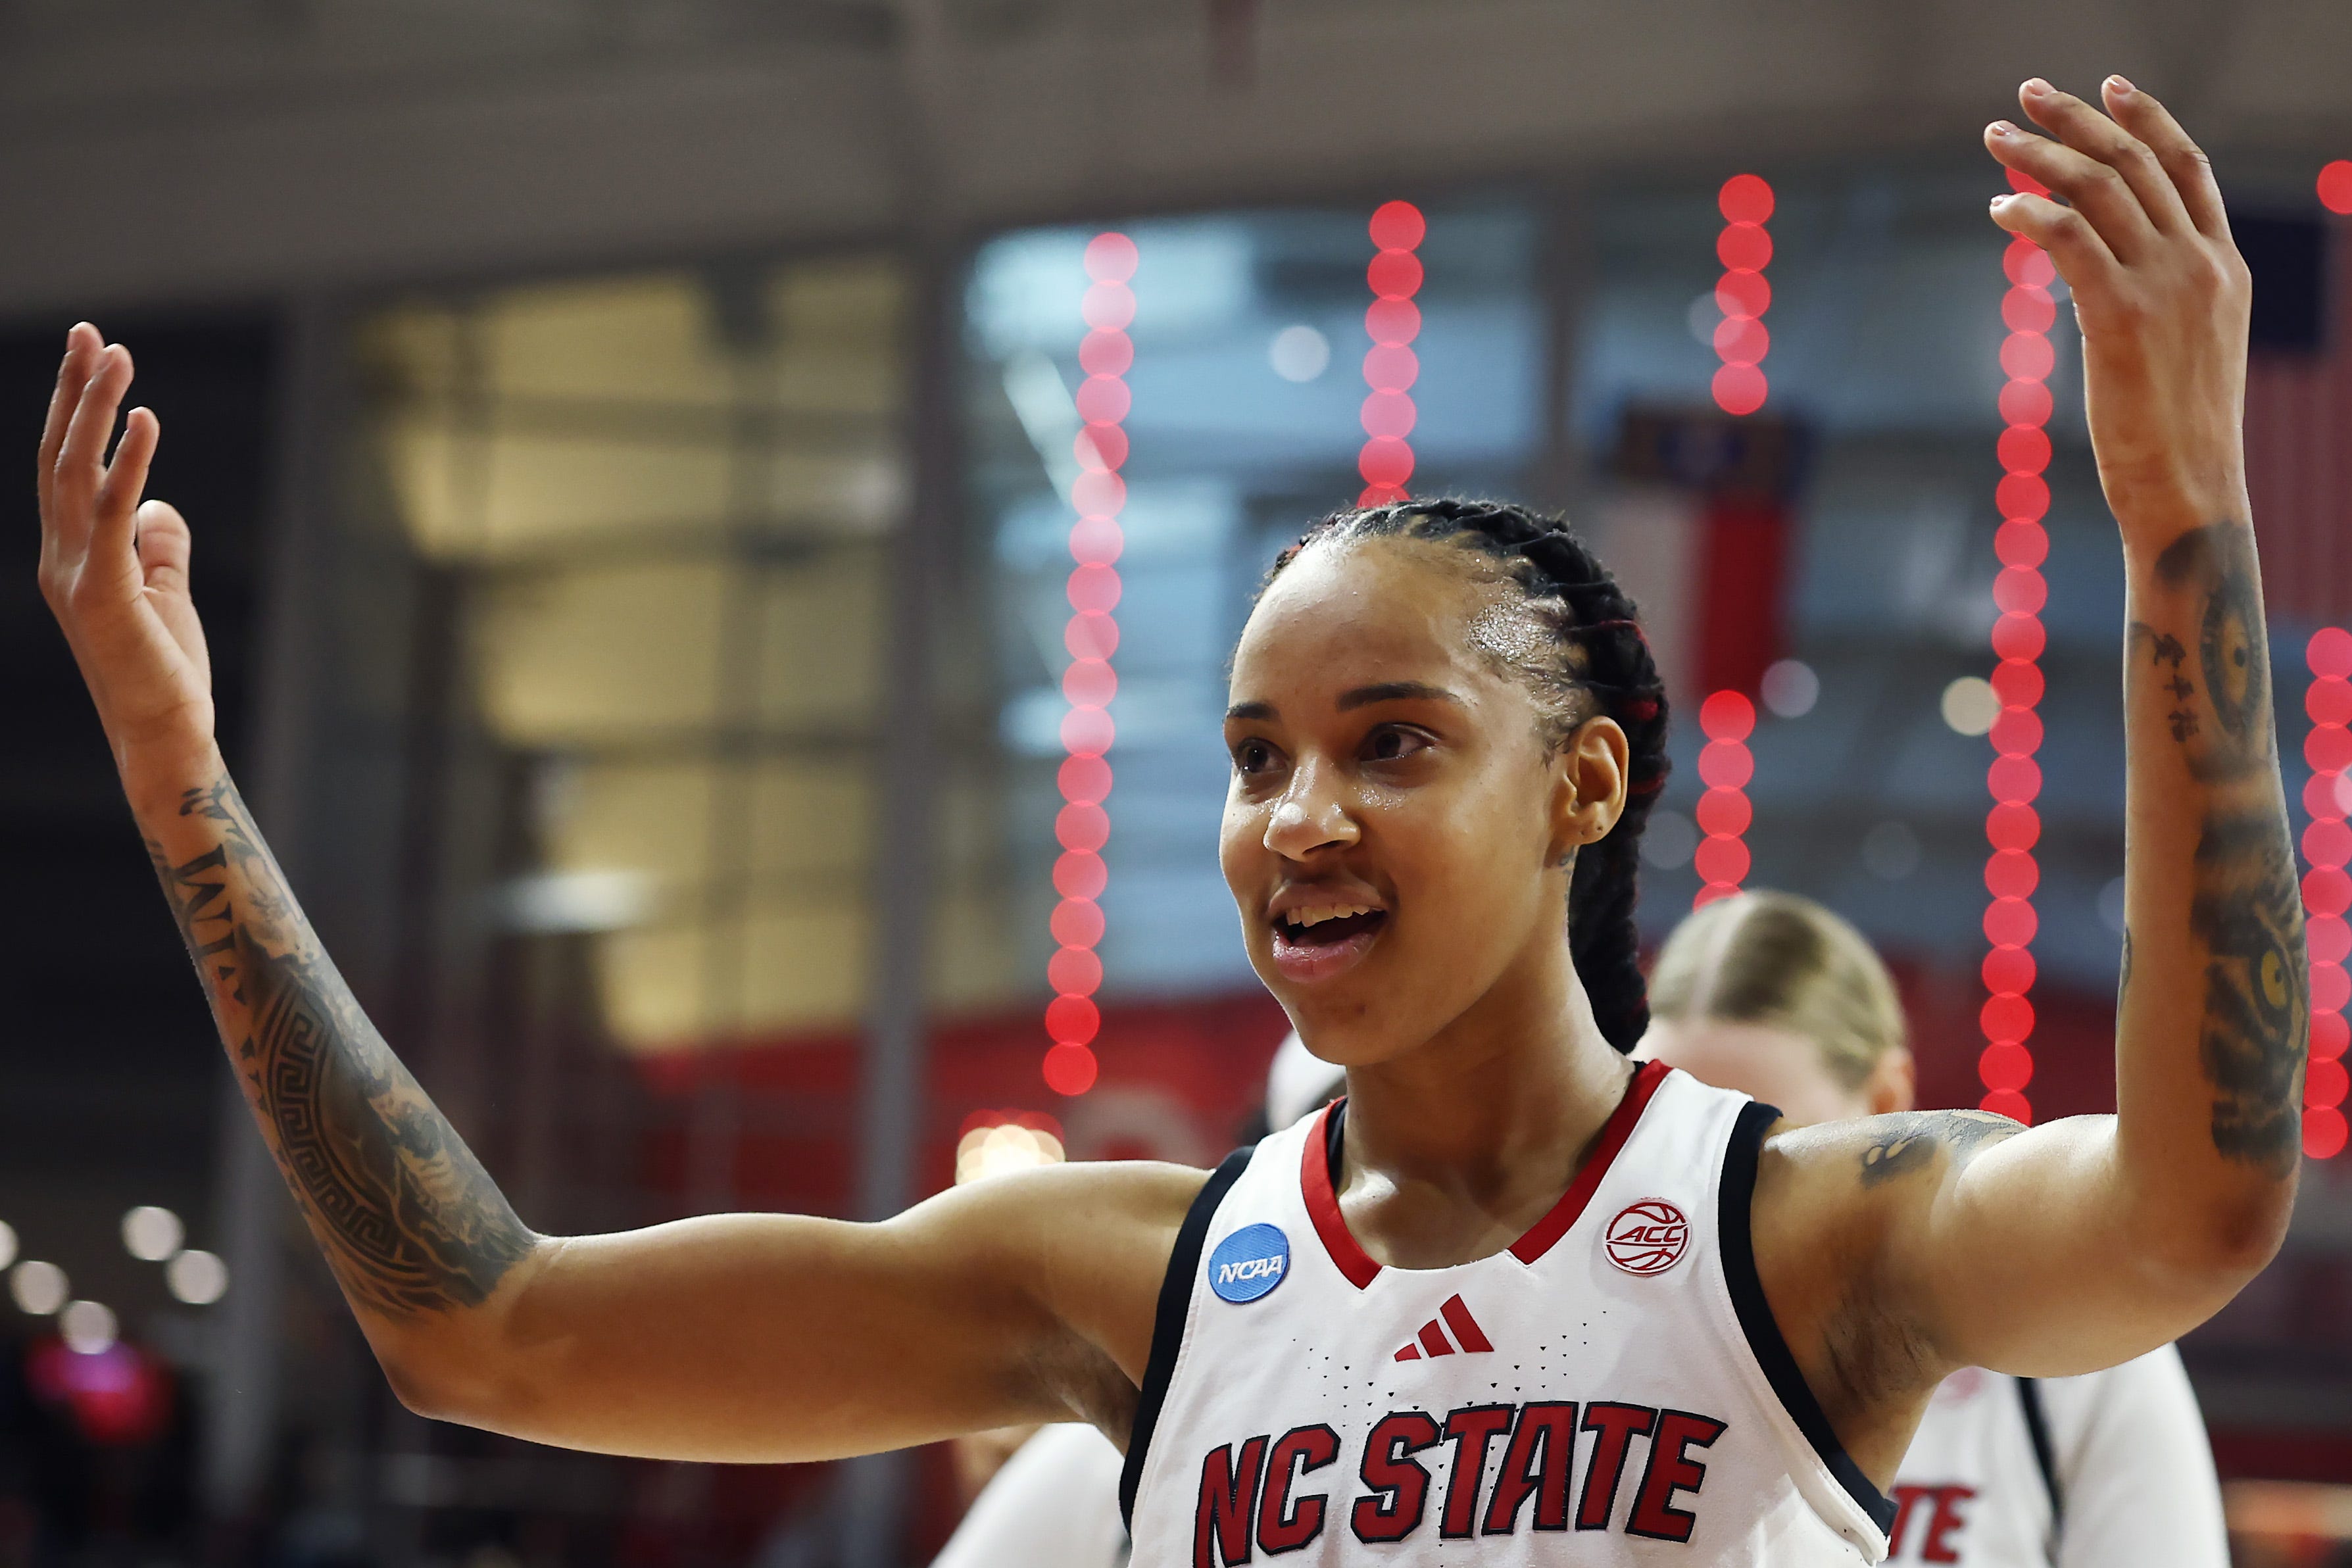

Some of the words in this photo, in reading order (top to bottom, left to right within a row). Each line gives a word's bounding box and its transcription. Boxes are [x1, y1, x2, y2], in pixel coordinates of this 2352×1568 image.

[1614, 1223, 1688, 1243] ACC
[1217, 1254, 1283, 1285] NCAA
[1192, 1423, 1342, 1568] NC
[1350, 1401, 1728, 1544] STATE
